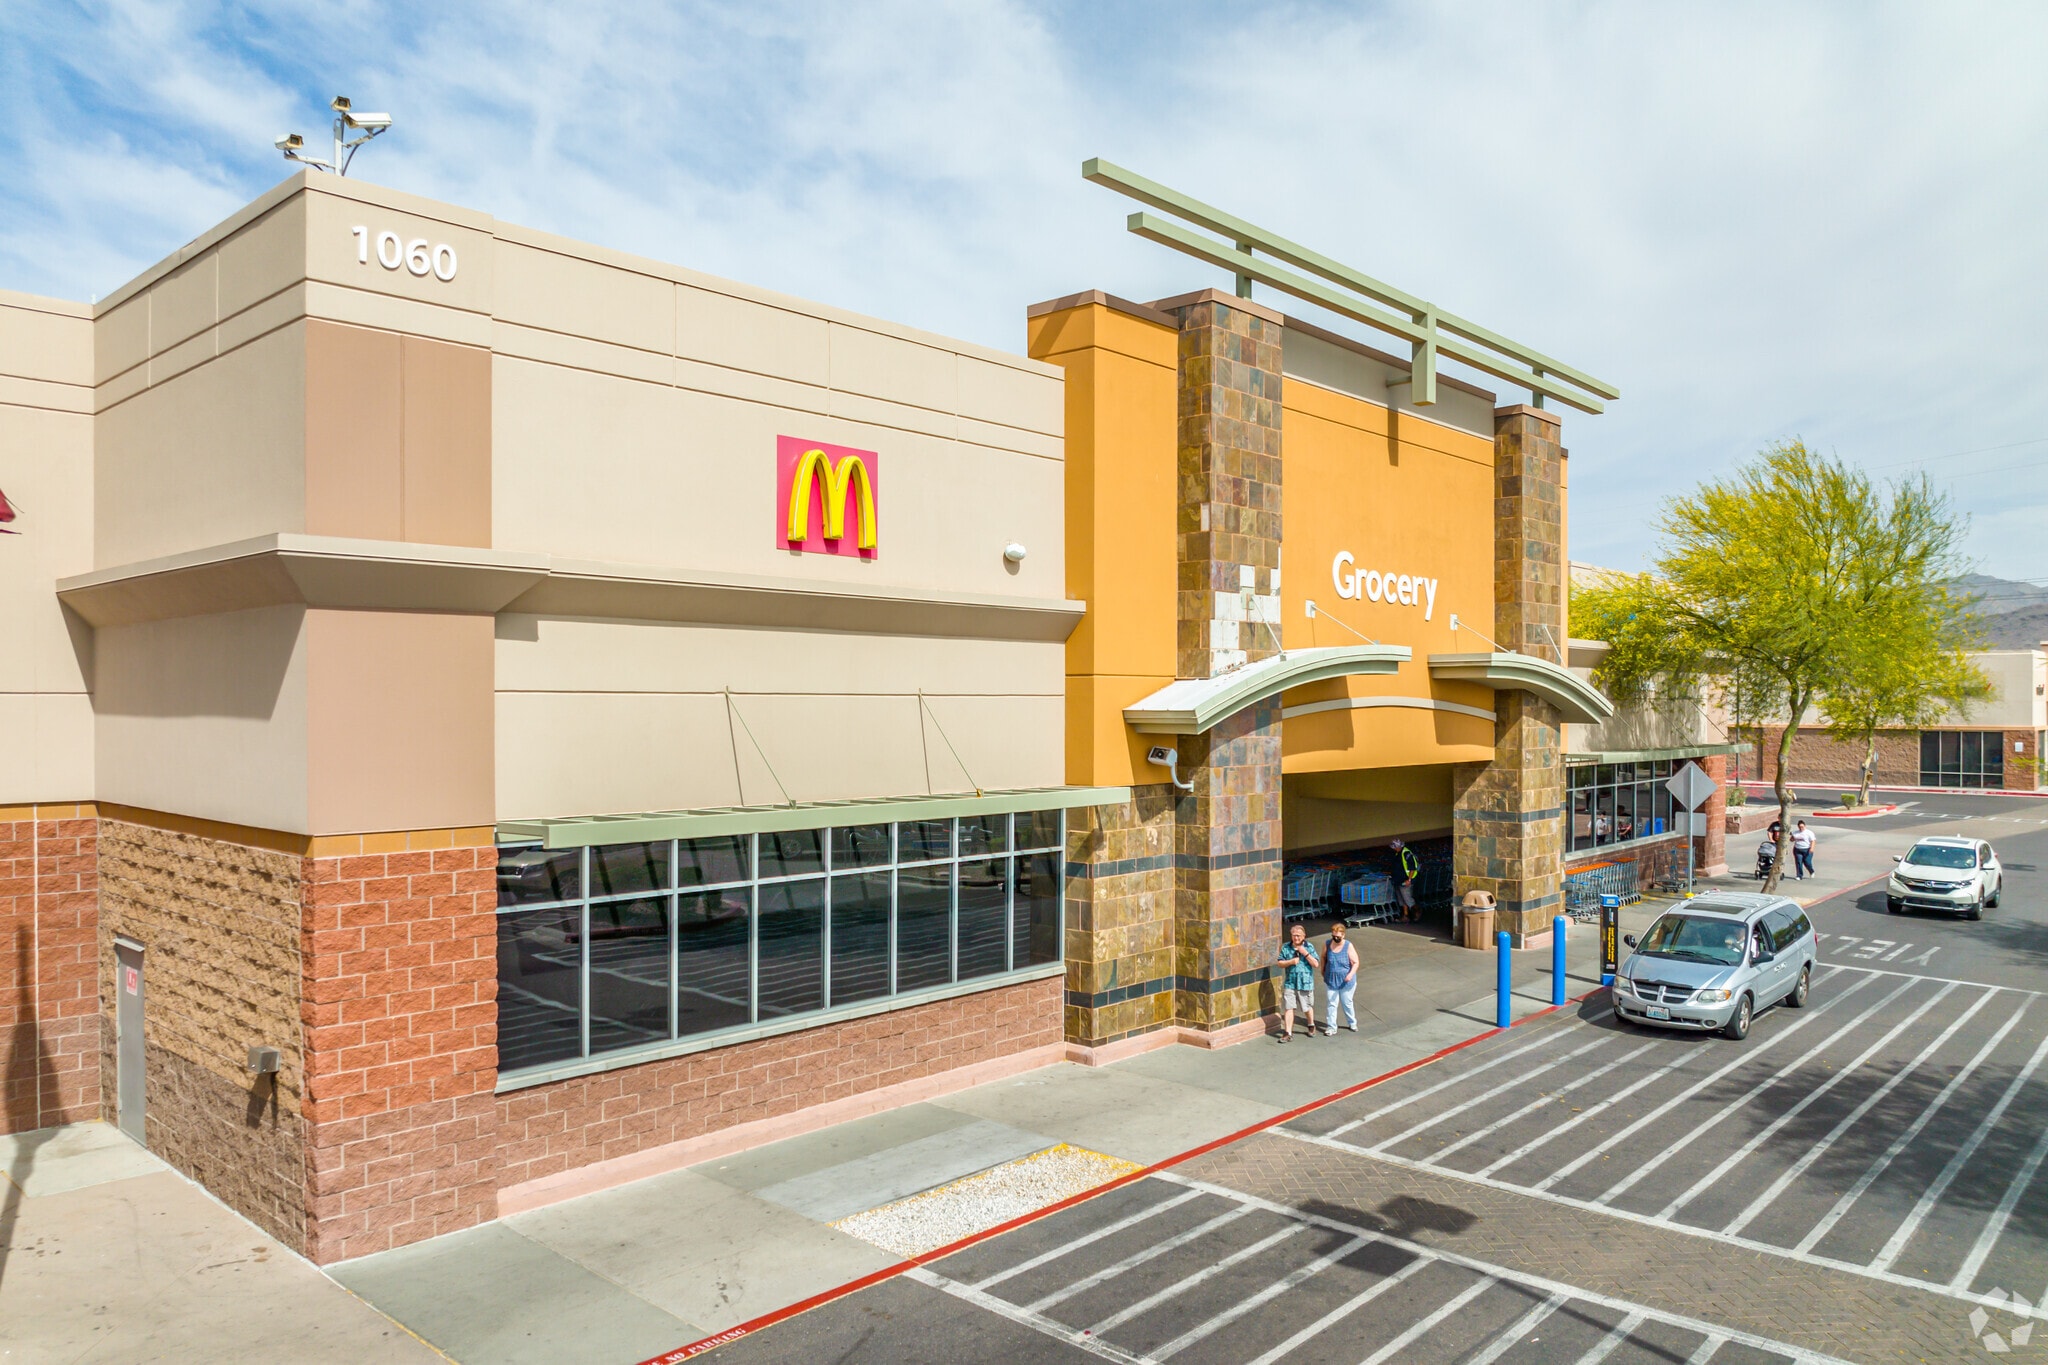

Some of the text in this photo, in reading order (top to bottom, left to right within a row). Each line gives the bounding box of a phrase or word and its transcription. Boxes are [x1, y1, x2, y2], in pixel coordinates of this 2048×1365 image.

[352, 226, 457, 282] 1060
[1332, 550, 1438, 622] Grocery
[665, 1328, 746, 1363] NO PARKING
